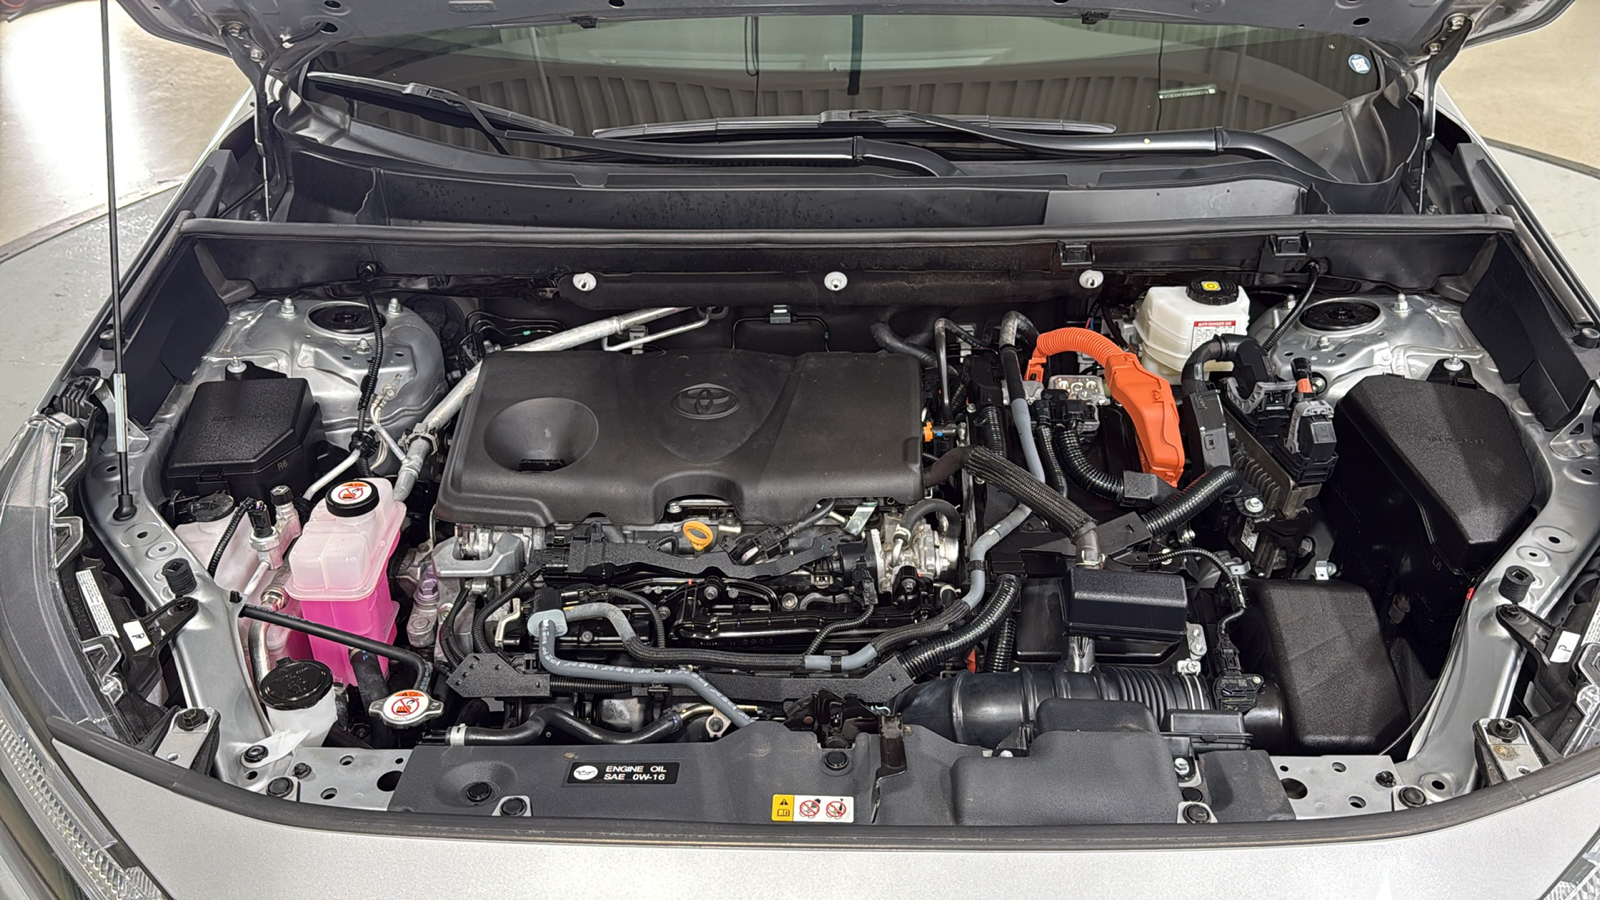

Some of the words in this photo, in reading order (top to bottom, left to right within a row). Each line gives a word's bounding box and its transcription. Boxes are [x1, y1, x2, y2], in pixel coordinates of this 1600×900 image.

[277, 460, 288, 471] R6
[605, 765, 644, 773] ENGINE
[650, 765, 667, 773] OIL
[603, 773, 626, 781] SAE
[632, 773, 666, 781] 0W-16
